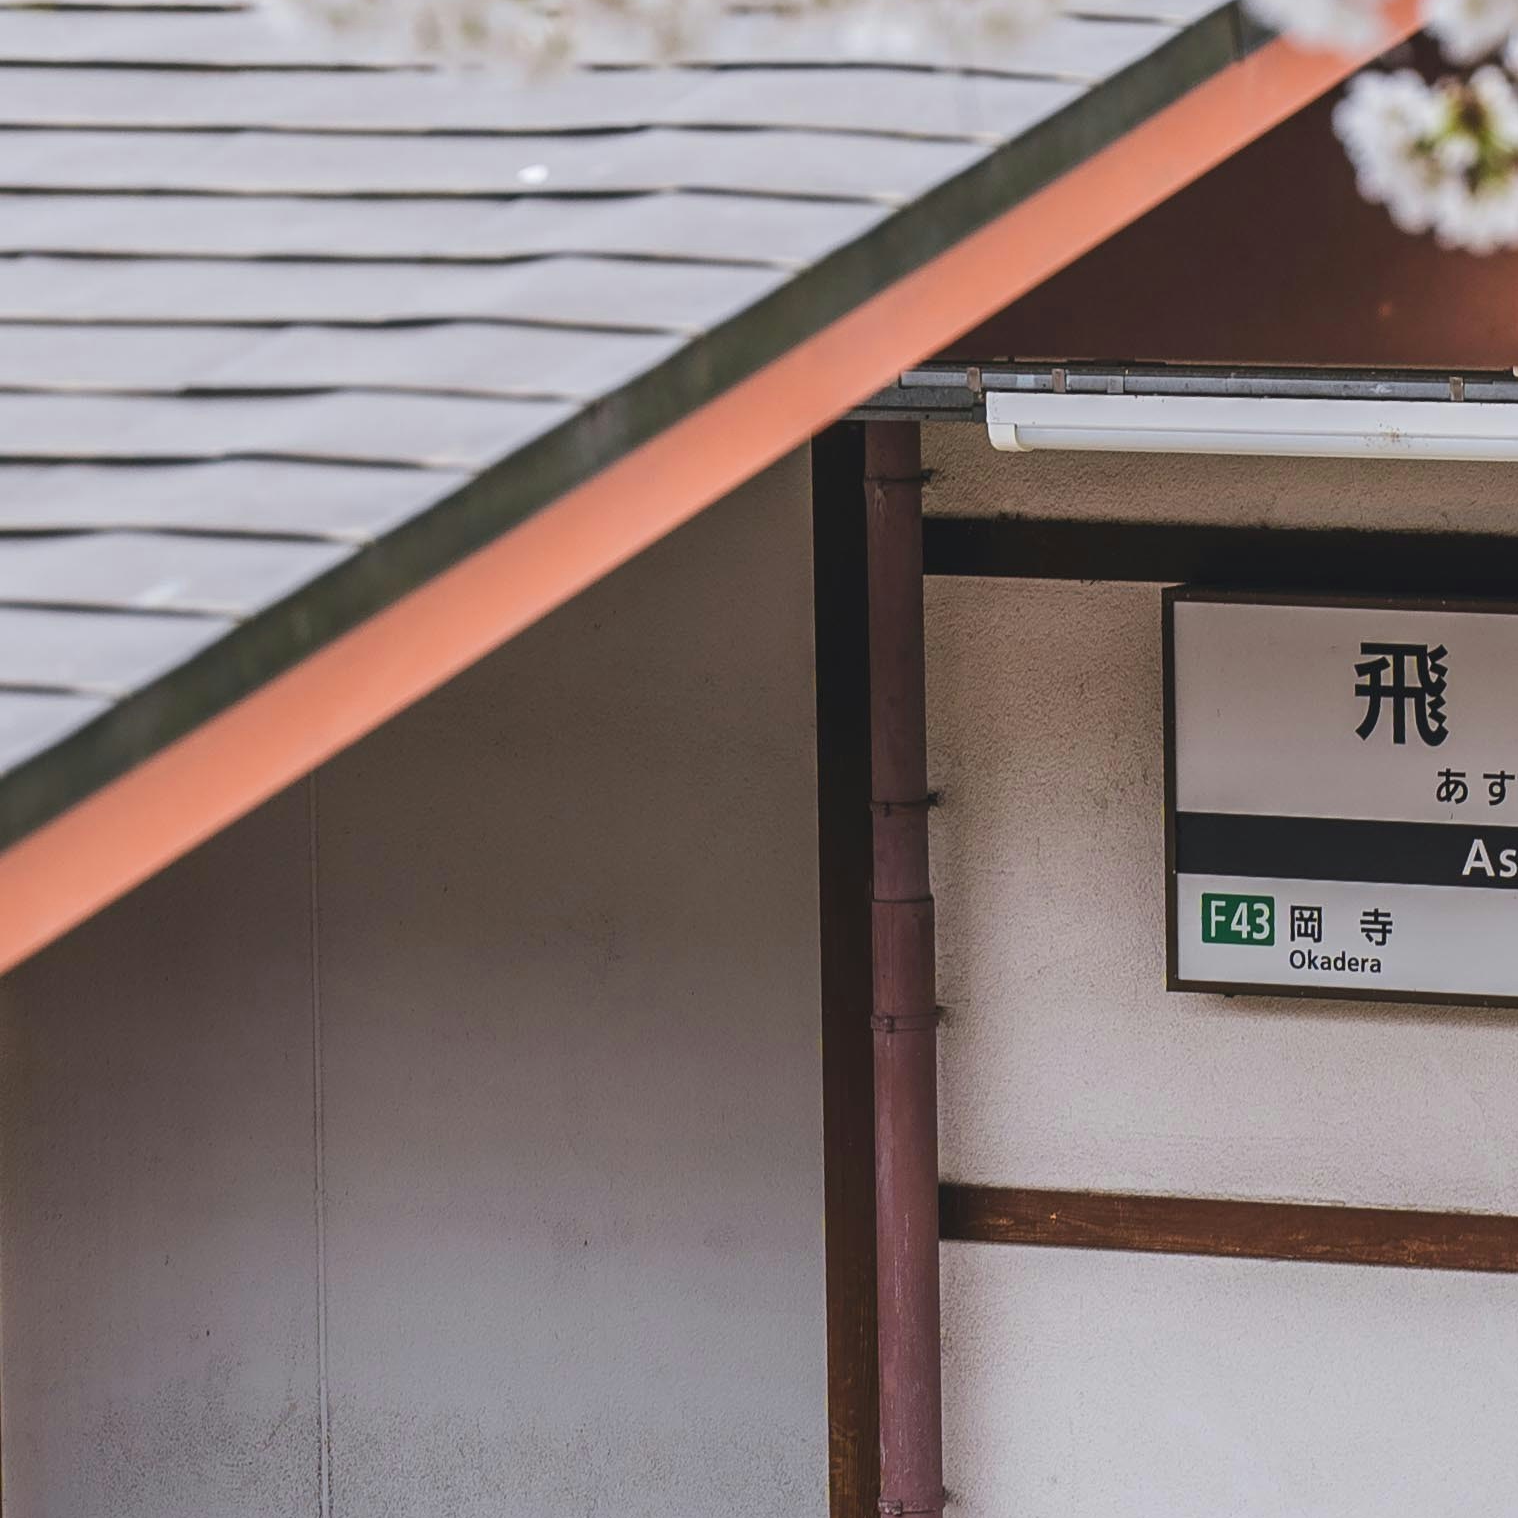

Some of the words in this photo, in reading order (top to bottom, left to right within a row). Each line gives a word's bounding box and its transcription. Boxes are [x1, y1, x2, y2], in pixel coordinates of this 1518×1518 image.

[1210, 900, 1271, 940] F43
[1289, 905, 1394, 947] 岡寺
[1289, 949, 1382, 973] Okadera
